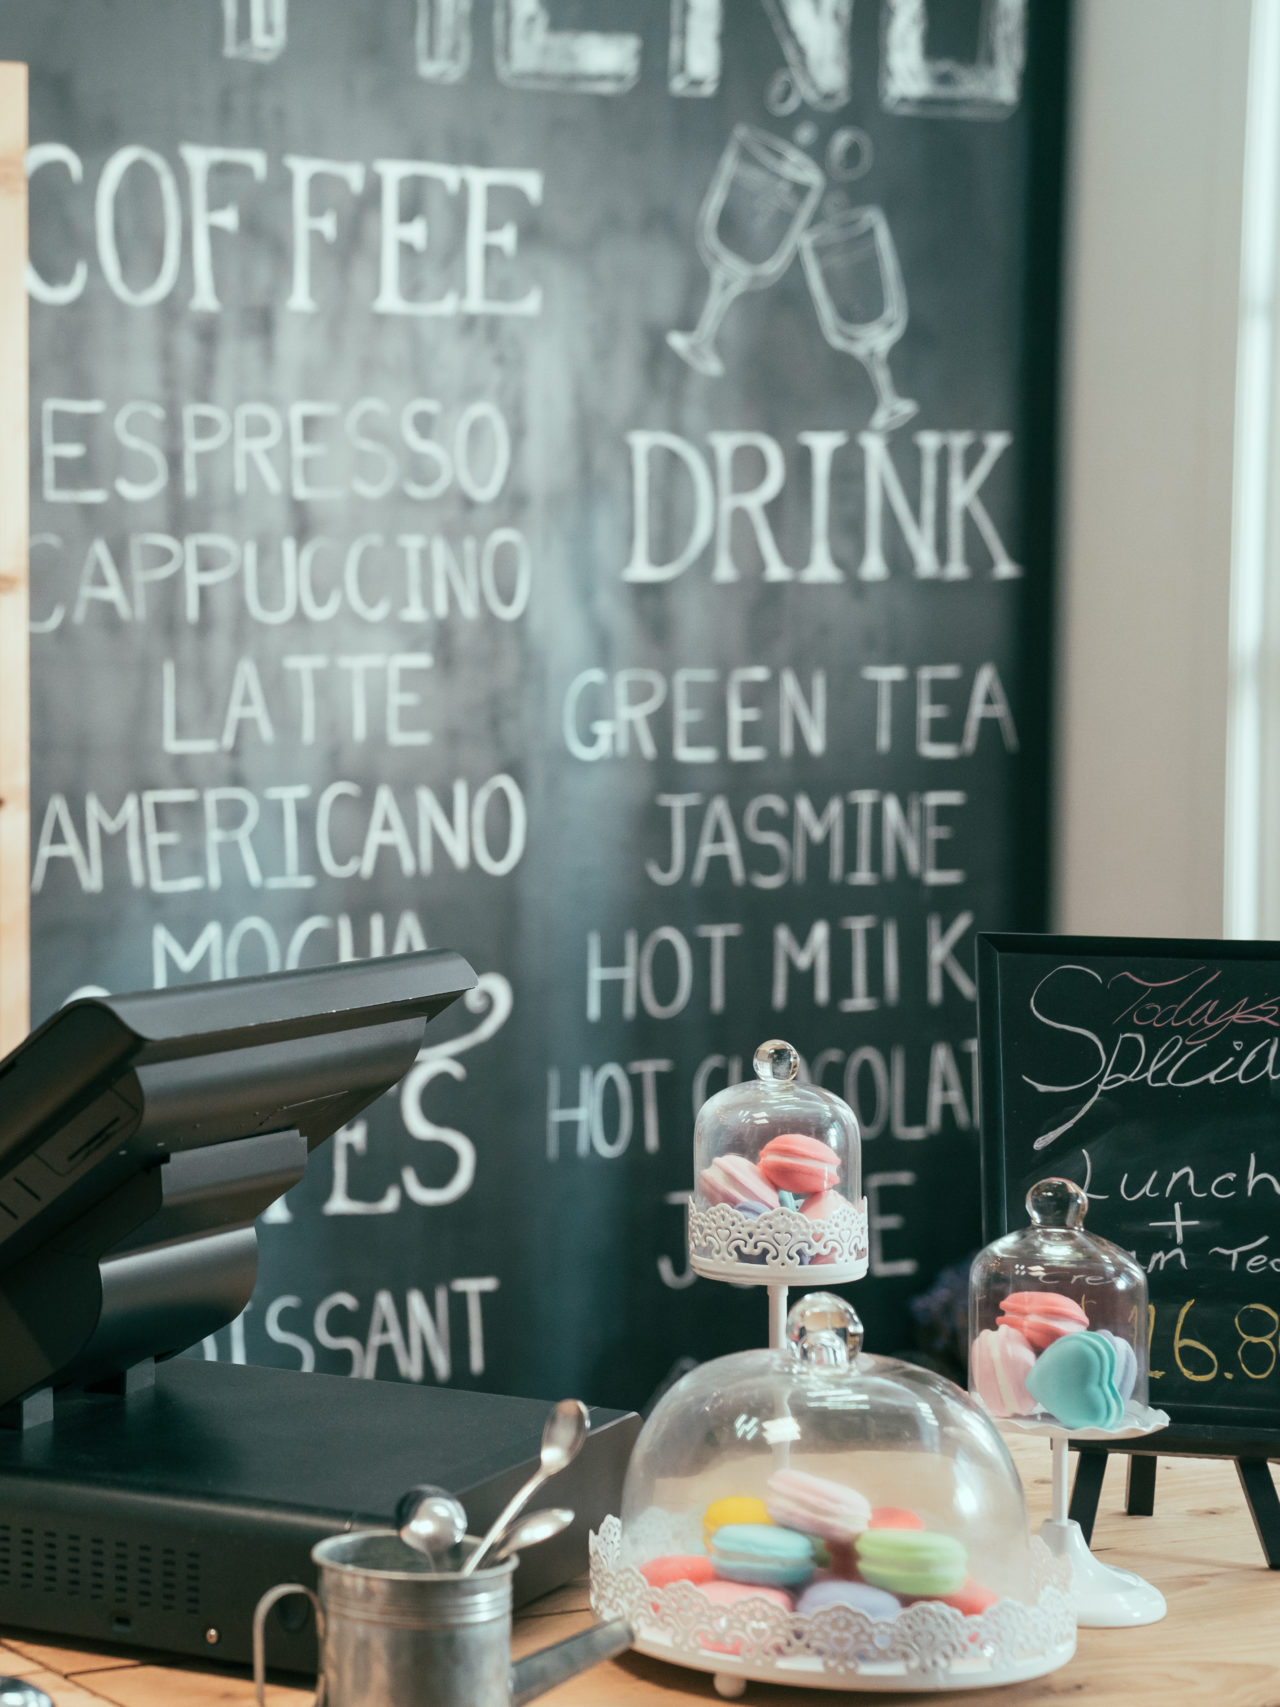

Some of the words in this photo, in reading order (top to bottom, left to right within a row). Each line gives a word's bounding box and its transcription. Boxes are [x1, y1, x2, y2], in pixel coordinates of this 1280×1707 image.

[27, 142, 544, 317] COFFEE
[41, 398, 511, 502] ESPRESSO
[622, 429, 1022, 583] DRINK
[28, 528, 531, 633] CAPPUCCINO
[162, 653, 434, 754] LATTE
[562, 665, 826, 763] GREEN
[861, 662, 1018, 760] TEA
[30, 773, 528, 893] AMERICANO
[645, 789, 967, 889] JASMINE
[586, 923, 743, 1022] HOT
[546, 1058, 675, 1161] HOT
[1081, 1149, 1280, 1201] Lunch
[200, 1276, 500, 1382] ISSANT
[1128, 1299, 1280, 1382] 16.8
